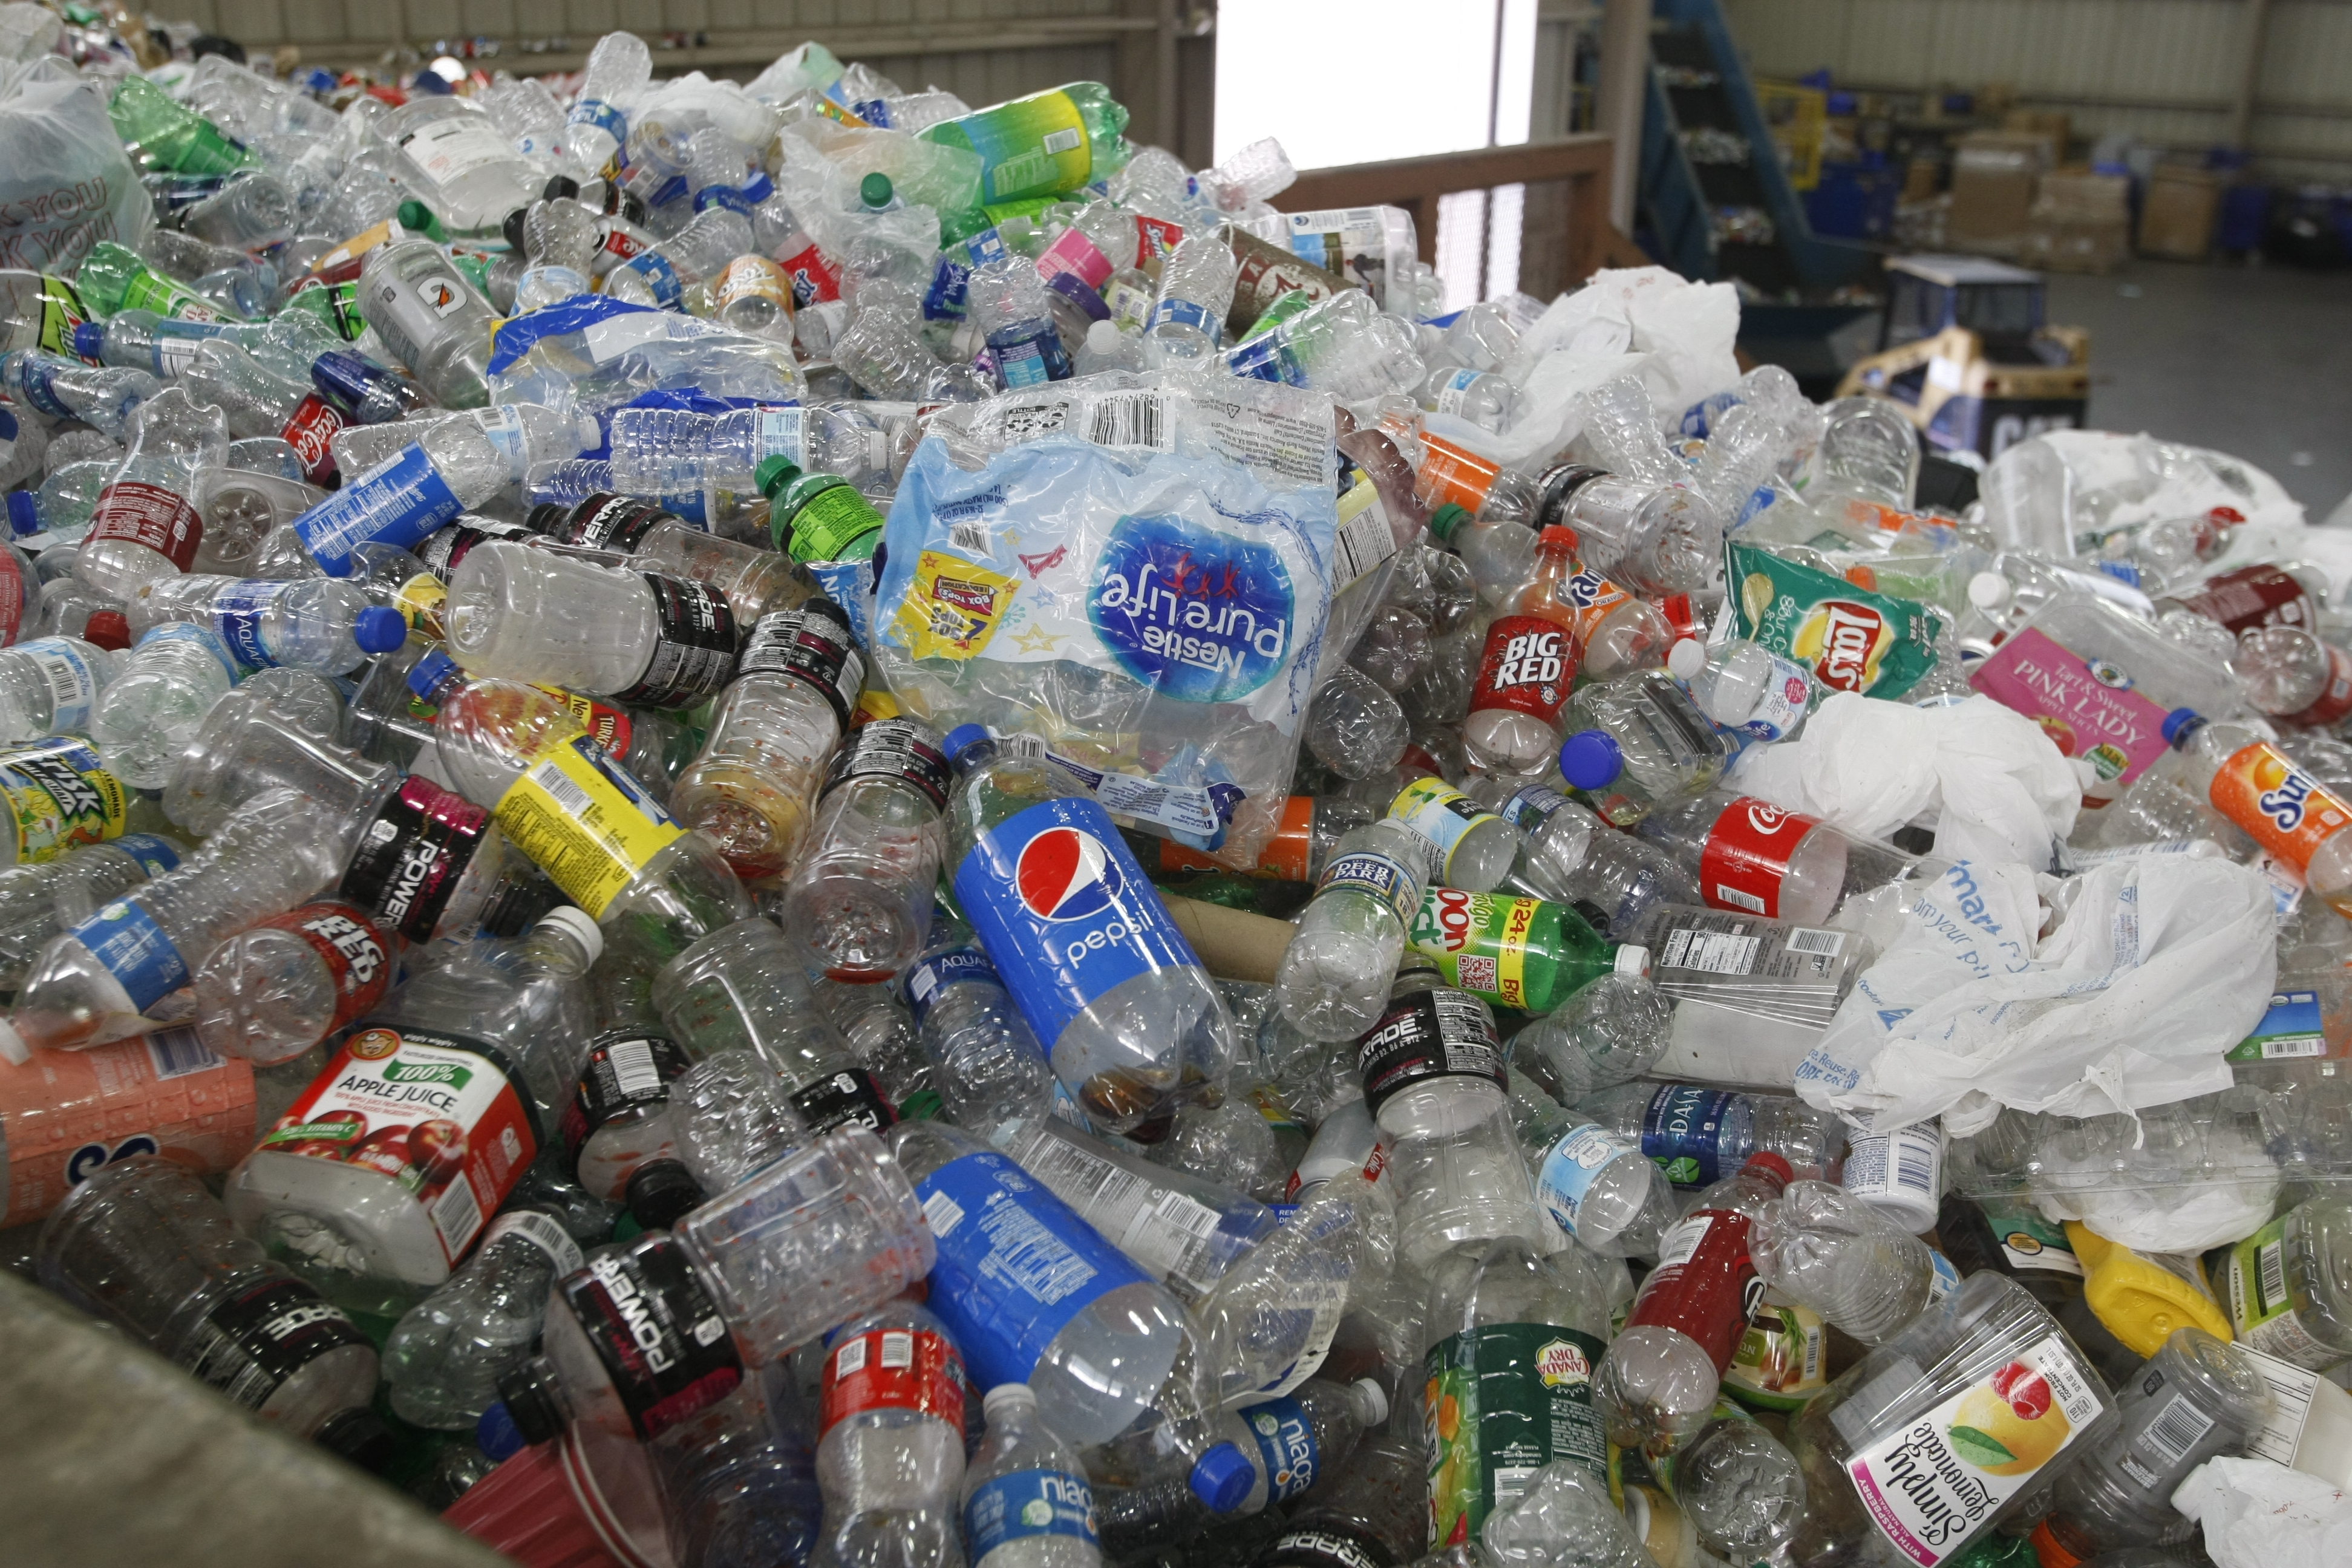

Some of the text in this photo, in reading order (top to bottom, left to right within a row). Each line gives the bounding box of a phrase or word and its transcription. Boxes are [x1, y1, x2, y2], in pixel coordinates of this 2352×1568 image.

[19, 177, 107, 223] YOU
[1129, 394, 1155, 402] 68274
[942, 581, 981, 594] EDUCATION
[942, 589, 990, 605] BOX TOPS
[1595, 593, 1625, 607] ORANGE
[931, 607, 965, 629] TOPS
[1101, 562, 1287, 659] Life Pure
[1504, 632, 1561, 663] BIG
[1495, 656, 1561, 690] RED
[2013, 659, 2147, 746] PINK LADY
[2037, 694, 2065, 715] APPLE
[2053, 663, 2083, 690] Tart
[2091, 687, 2138, 722] Sweet
[599, 714, 616, 749] TURKE
[2099, 741, 2131, 771] NEW
[103, 771, 120, 820] LEMONADE
[1333, 869, 1388, 887] PARK
[1336, 862, 1389, 880] DEER
[327, 915, 384, 969] BIG
[1067, 909, 1152, 970] pepsi
[1507, 908, 1528, 956] 24 oz.
[1924, 913, 1973, 945] your
[304, 919, 374, 984] RED
[1661, 945, 1674, 966] Nutrition
[1687, 950, 1700, 969] Calories
[1500, 979, 1520, 1004] Big
[402, 1033, 454, 1048] piggly wiggly
[393, 1065, 459, 1082] 100%
[1818, 1053, 1847, 1076] Reuse.
[338, 1074, 459, 1113] APPLE JUICE
[1668, 1089, 1705, 1134] DASA
[305, 1123, 344, 1135] VITAMIN
[1367, 1152, 1383, 1174] Coke
[2231, 1267, 2244, 1321] Wesson
[1534, 1357, 1591, 1376] CANADA
[1548, 1348, 1575, 1362] DRY
[2037, 1355, 2073, 1399] CONCENTRATE
[2043, 1371, 2068, 1402] NOT FROM
[2069, 1407, 2080, 1419] 110
[1913, 1422, 1999, 1522] Lemonade
[1884, 1434, 1966, 1546] Simply
[1858, 1478, 1922, 1559] WITH RASPBERRY
[1877, 1495, 1910, 1538] ALL NATURAL
